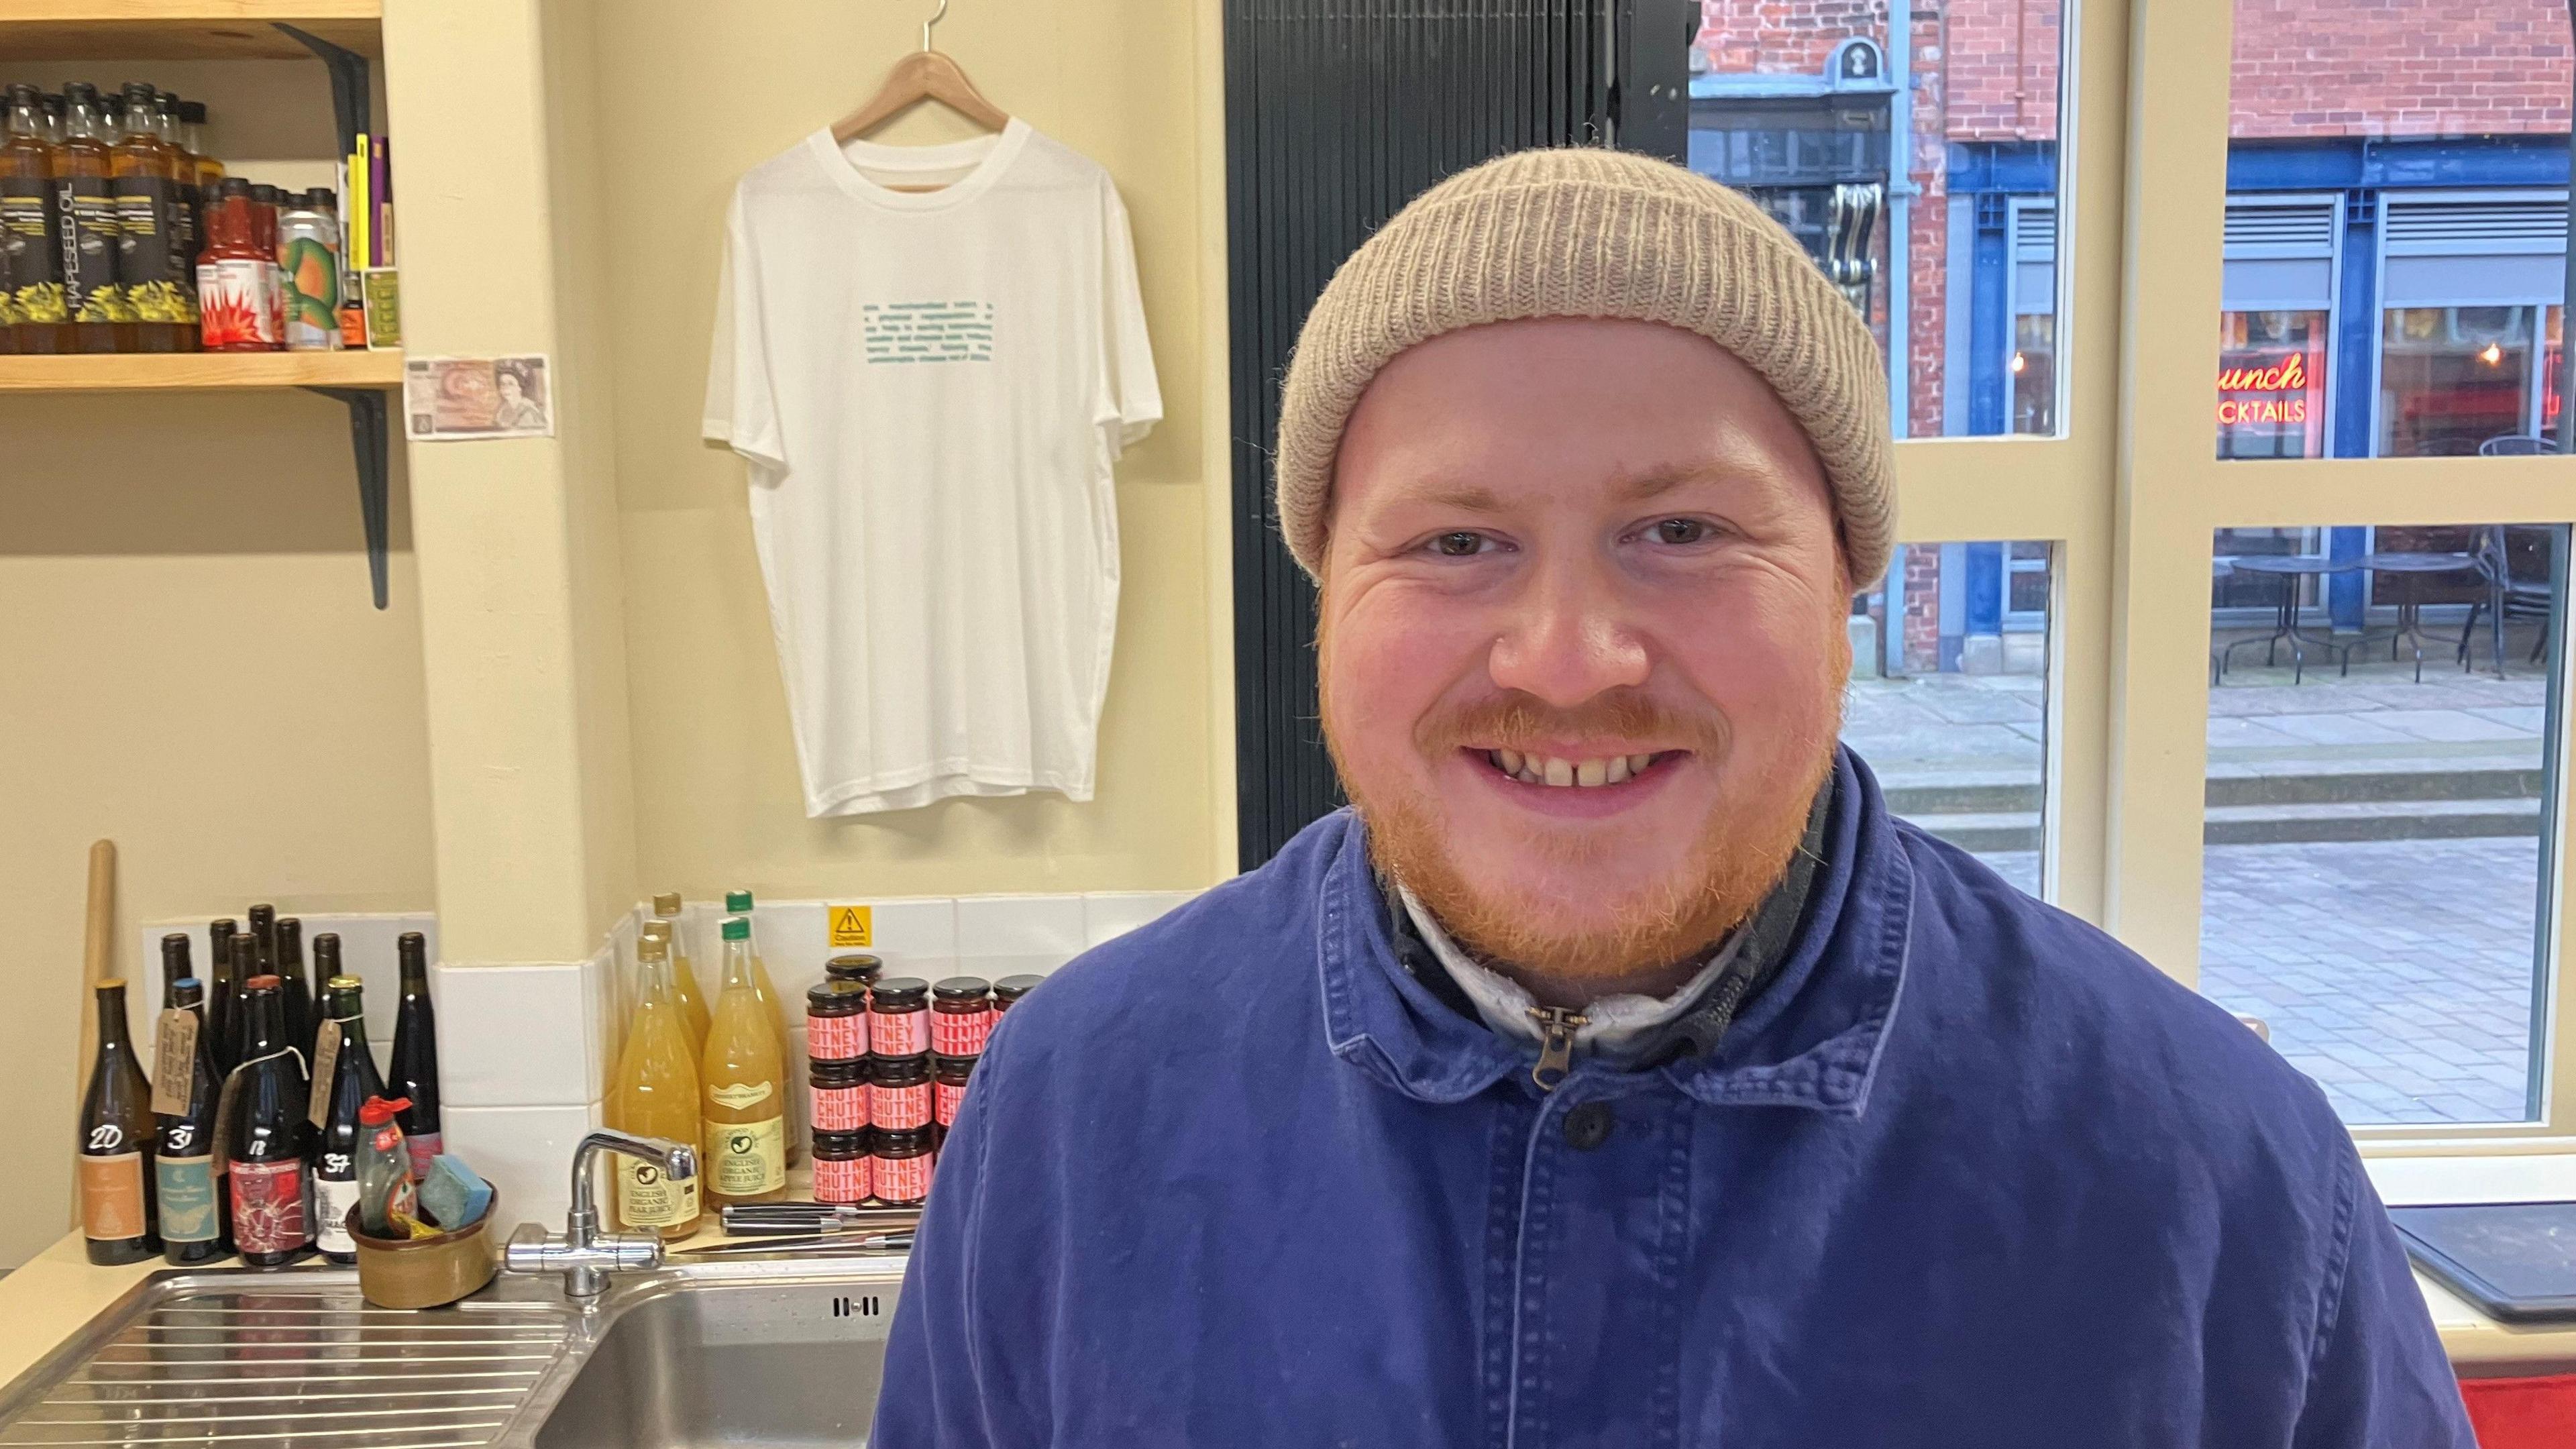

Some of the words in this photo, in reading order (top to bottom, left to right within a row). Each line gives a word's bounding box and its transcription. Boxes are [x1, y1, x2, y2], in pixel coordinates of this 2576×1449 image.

[59, 182, 74, 212] OIL
[88, 1124, 123, 1149] 20
[167, 1128, 193, 1150] 31
[324, 1152, 352, 1173] 37
